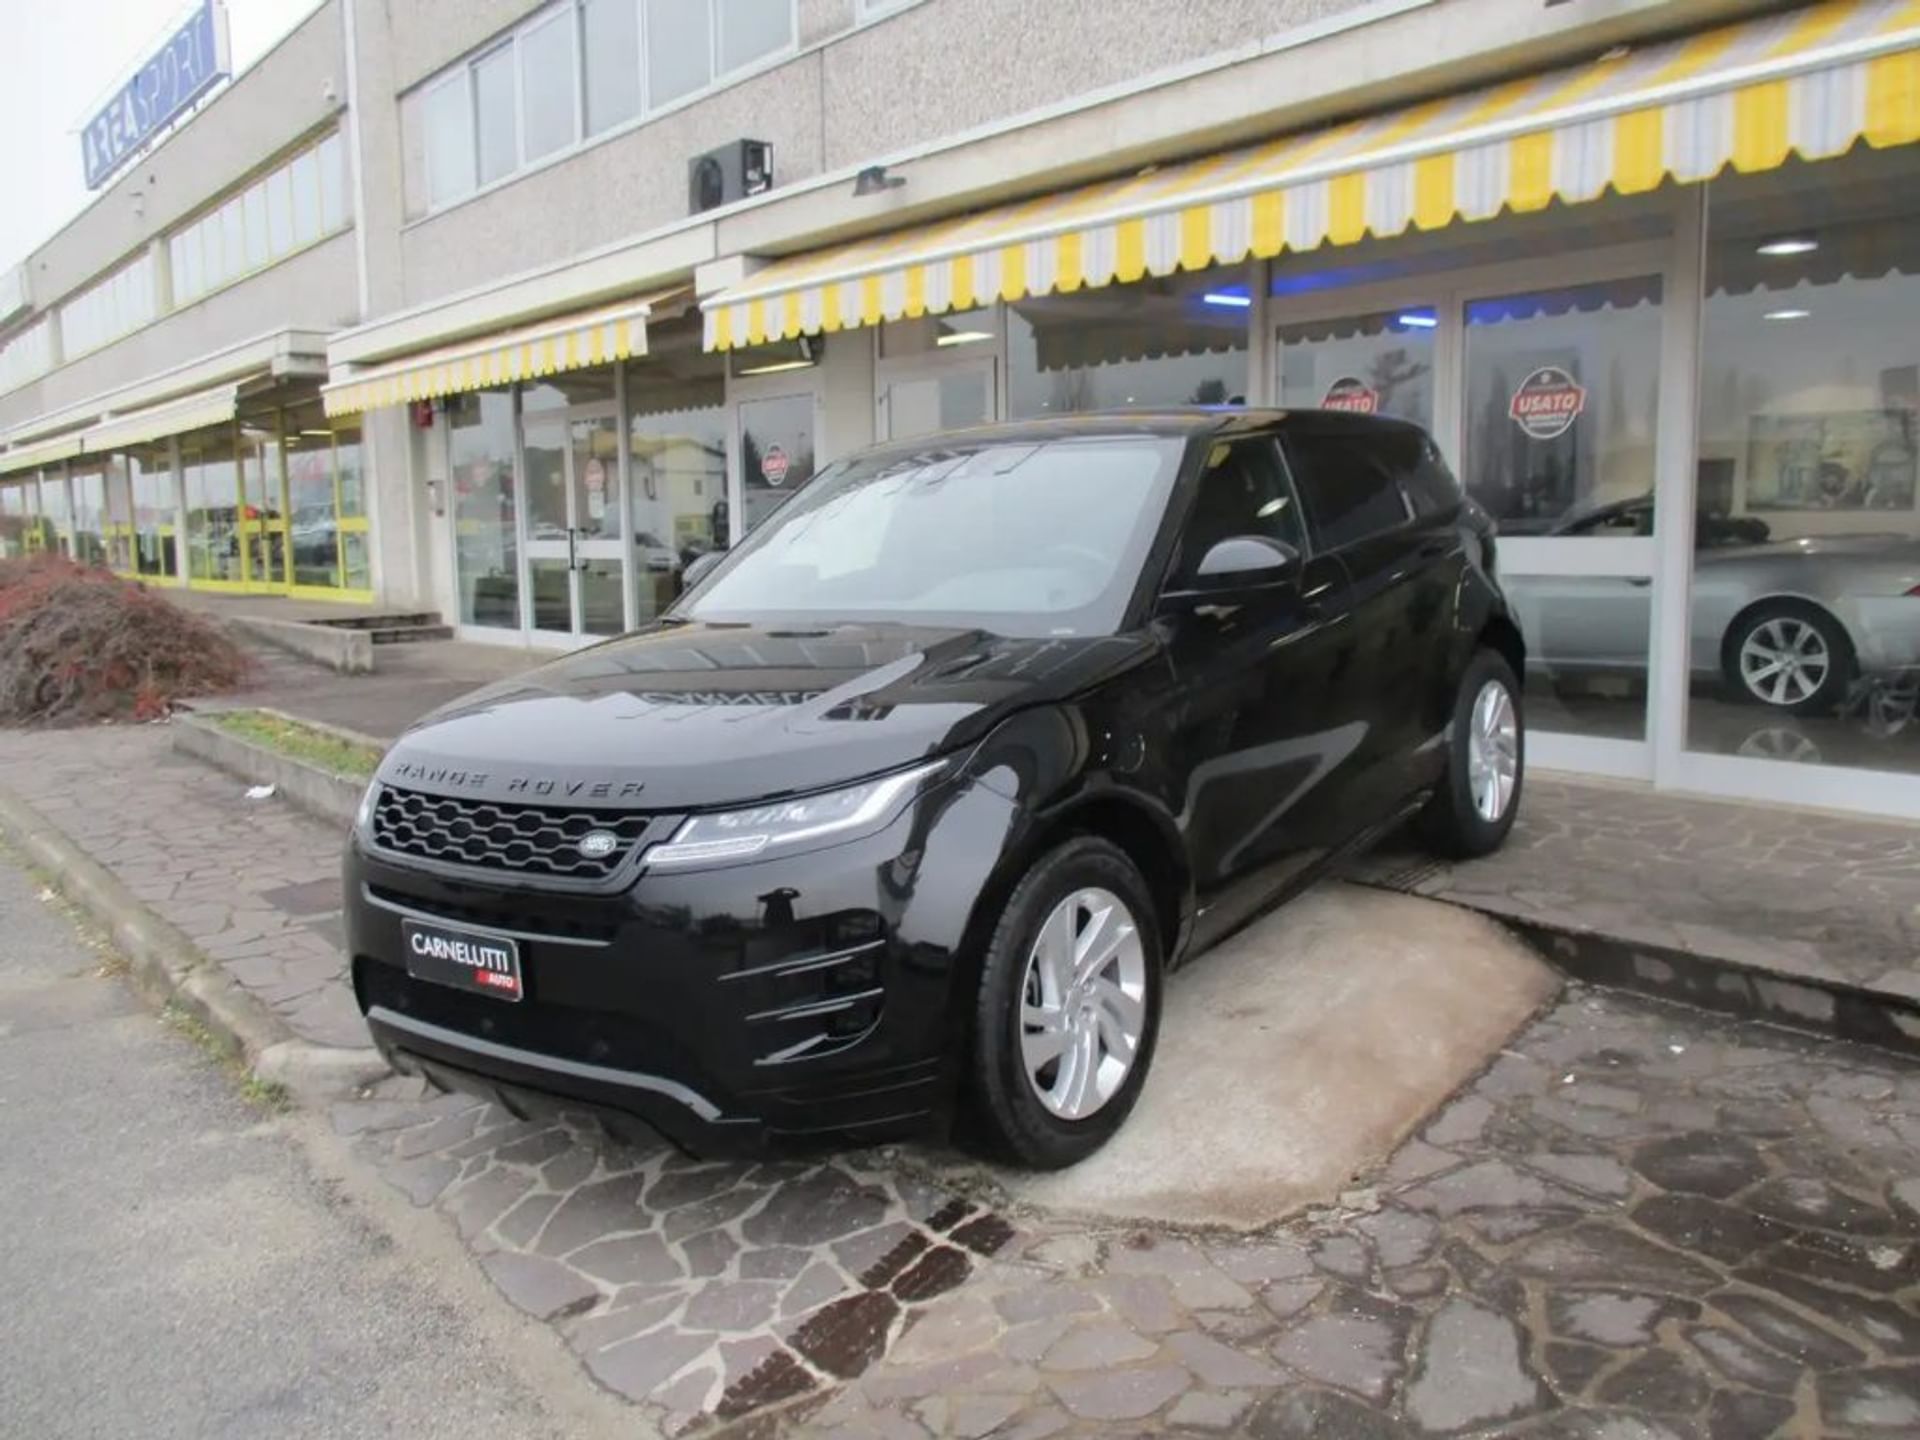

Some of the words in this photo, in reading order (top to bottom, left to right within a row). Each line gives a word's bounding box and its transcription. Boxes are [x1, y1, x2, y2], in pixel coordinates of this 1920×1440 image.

[1519, 392, 1576, 413] USATO
[396, 763, 489, 787] RANGE
[507, 779, 645, 797] ROVER
[411, 933, 508, 972] CARNELUTTI
[488, 973, 514, 988] AUTO
